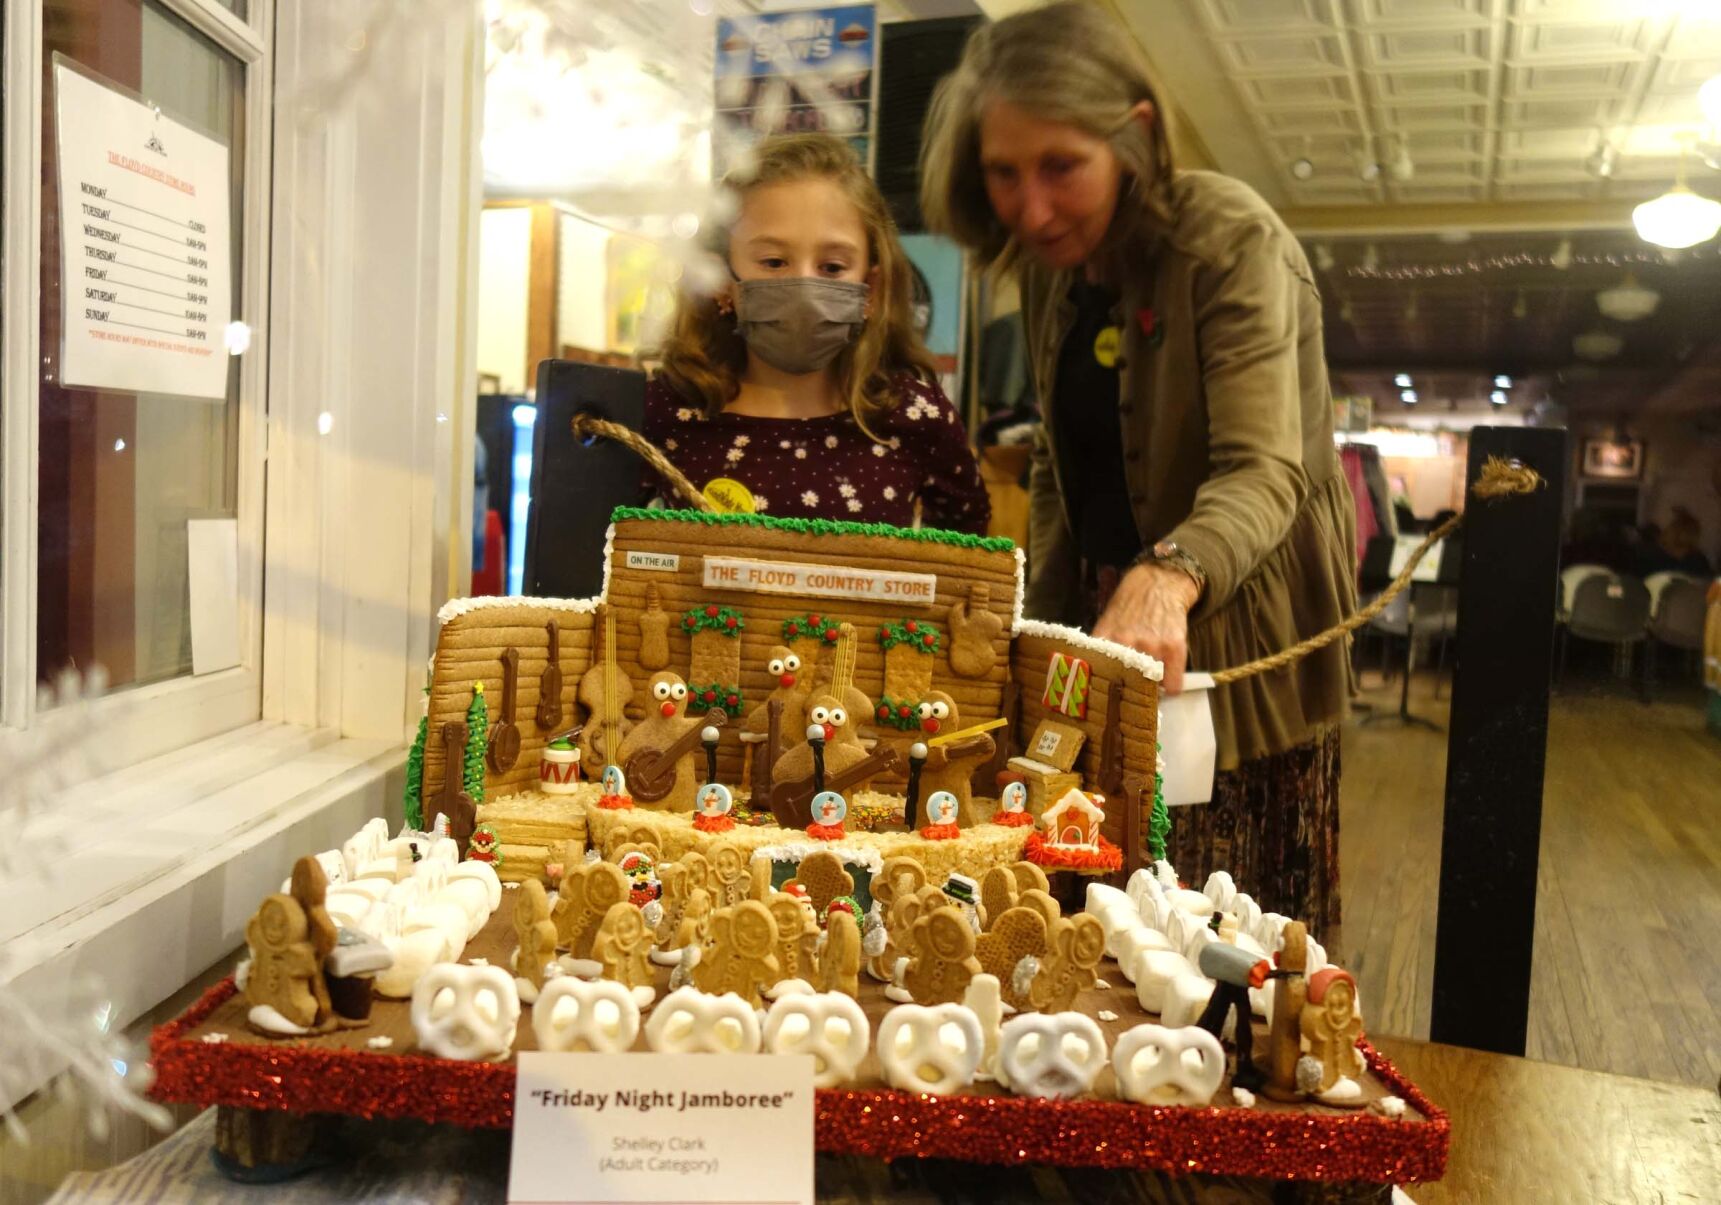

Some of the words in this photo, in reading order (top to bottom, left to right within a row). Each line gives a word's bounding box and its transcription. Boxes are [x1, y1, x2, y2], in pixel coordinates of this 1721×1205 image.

[81, 182, 107, 199] MONDAY
[82, 203, 111, 220] TUESDAY
[83, 224, 120, 244] WEDNESDAY
[84, 245, 117, 262] THURSDAY
[85, 266, 107, 281] FRIDAY
[85, 287, 117, 303] SATURDAY
[85, 308, 109, 322] SUNDAY
[630, 555, 642, 565] ON
[644, 556, 660, 567] THE
[661, 558, 675, 568] AIR
[711, 565, 738, 581] THE
[749, 569, 796, 586] FLOYD
[806, 574, 874, 592] COUNTRY
[884, 581, 931, 597] STORE
[614, 1089, 675, 1112] Night
[612, 1136, 665, 1155] Shelley
[668, 1136, 706, 1151] Clark
[599, 1157, 644, 1174] (Adult
[647, 1157, 719, 1175] Category)
